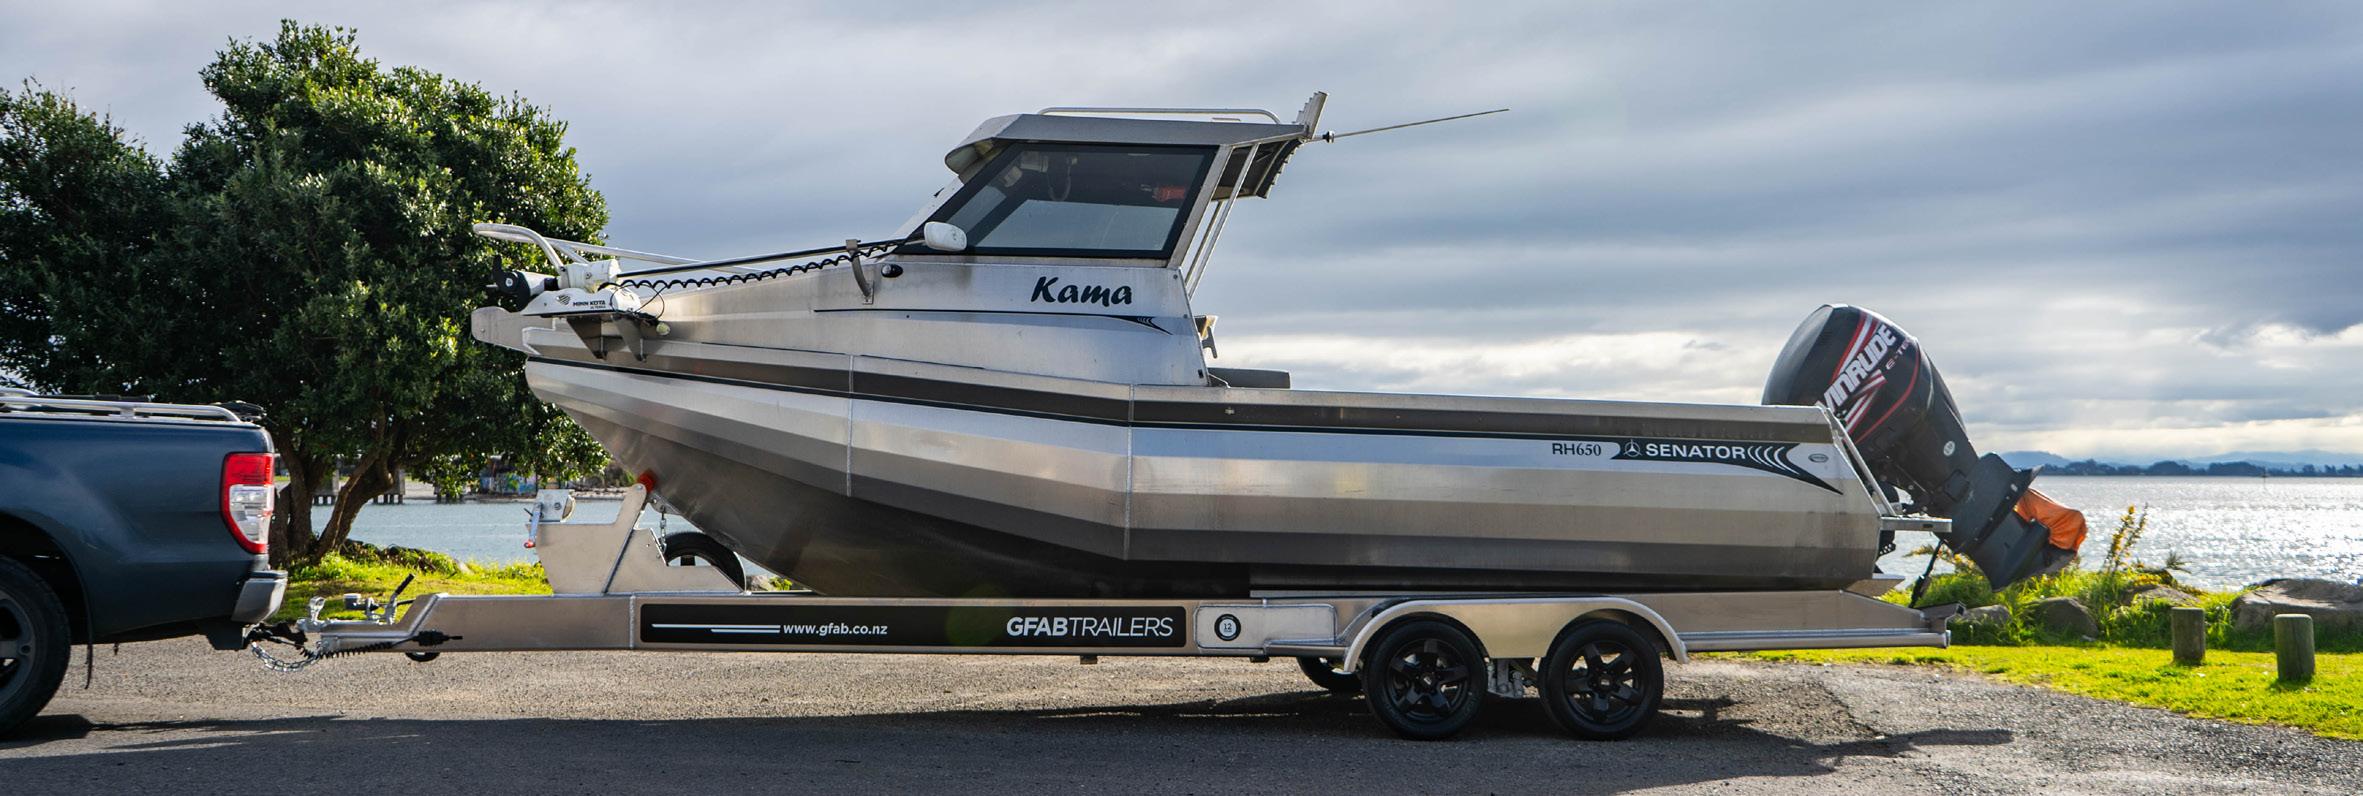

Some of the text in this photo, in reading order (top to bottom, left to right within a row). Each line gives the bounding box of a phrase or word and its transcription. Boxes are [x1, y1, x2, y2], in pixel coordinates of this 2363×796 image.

[1030, 276, 1133, 307] Kama
[1823, 324, 1897, 413] INRUDE
[1551, 442, 1746, 460] RH650 SENATOR
[783, 622, 888, 636] www.gfab.co.nz
